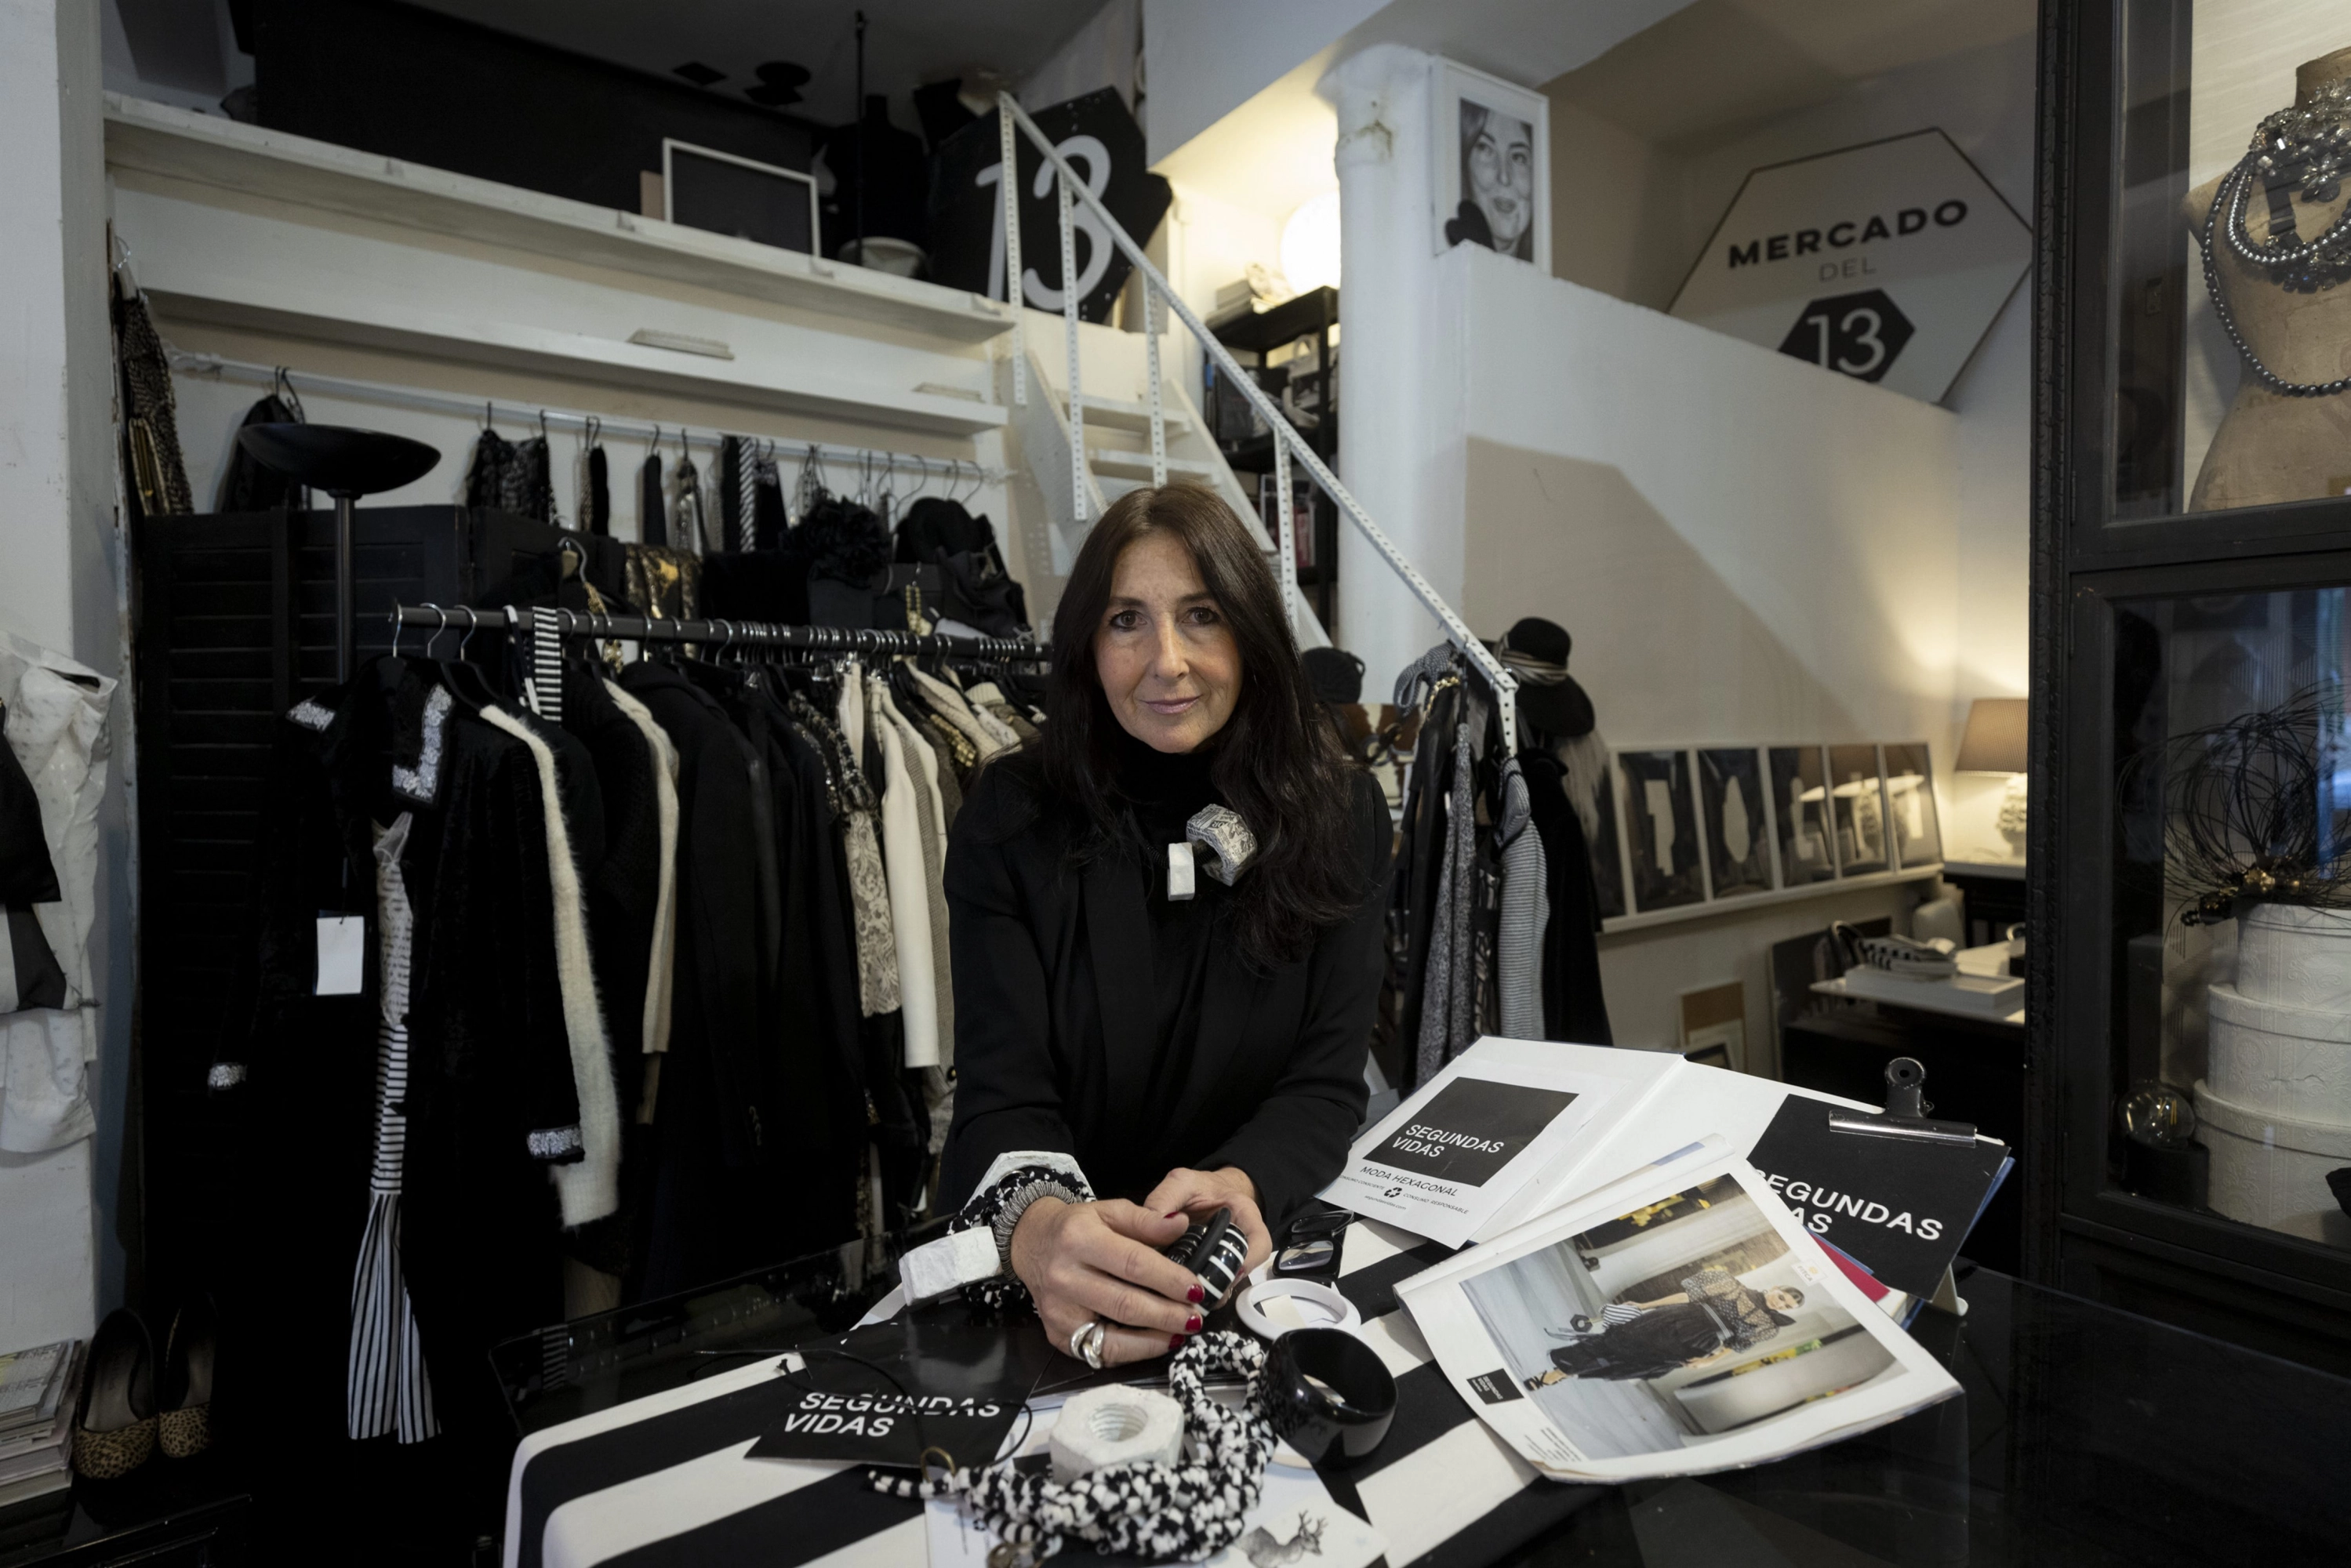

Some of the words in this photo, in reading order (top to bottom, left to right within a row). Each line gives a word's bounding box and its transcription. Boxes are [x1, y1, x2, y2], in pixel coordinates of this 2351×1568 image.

[975, 135, 1114, 310] 13
[1728, 199, 1968, 269] MERCADO
[1819, 257, 1877, 282] DEL
[1807, 307, 1886, 375] 13
[1392, 1137, 1445, 1157] VIDAS
[1405, 1124, 1505, 1153] SEGUNDAS
[1339, 1174, 1358, 1183] ONSUMO
[1360, 1166, 1392, 1180] MODA
[1391, 1174, 1459, 1196] HEXAGONAL
[1403, 1192, 1430, 1203] CONSUMO
[1430, 1200, 1470, 1214] RESPONSABLE
[800, 1392, 1001, 1417] SEGUNDAS
[784, 1413, 894, 1437] VIDAS
